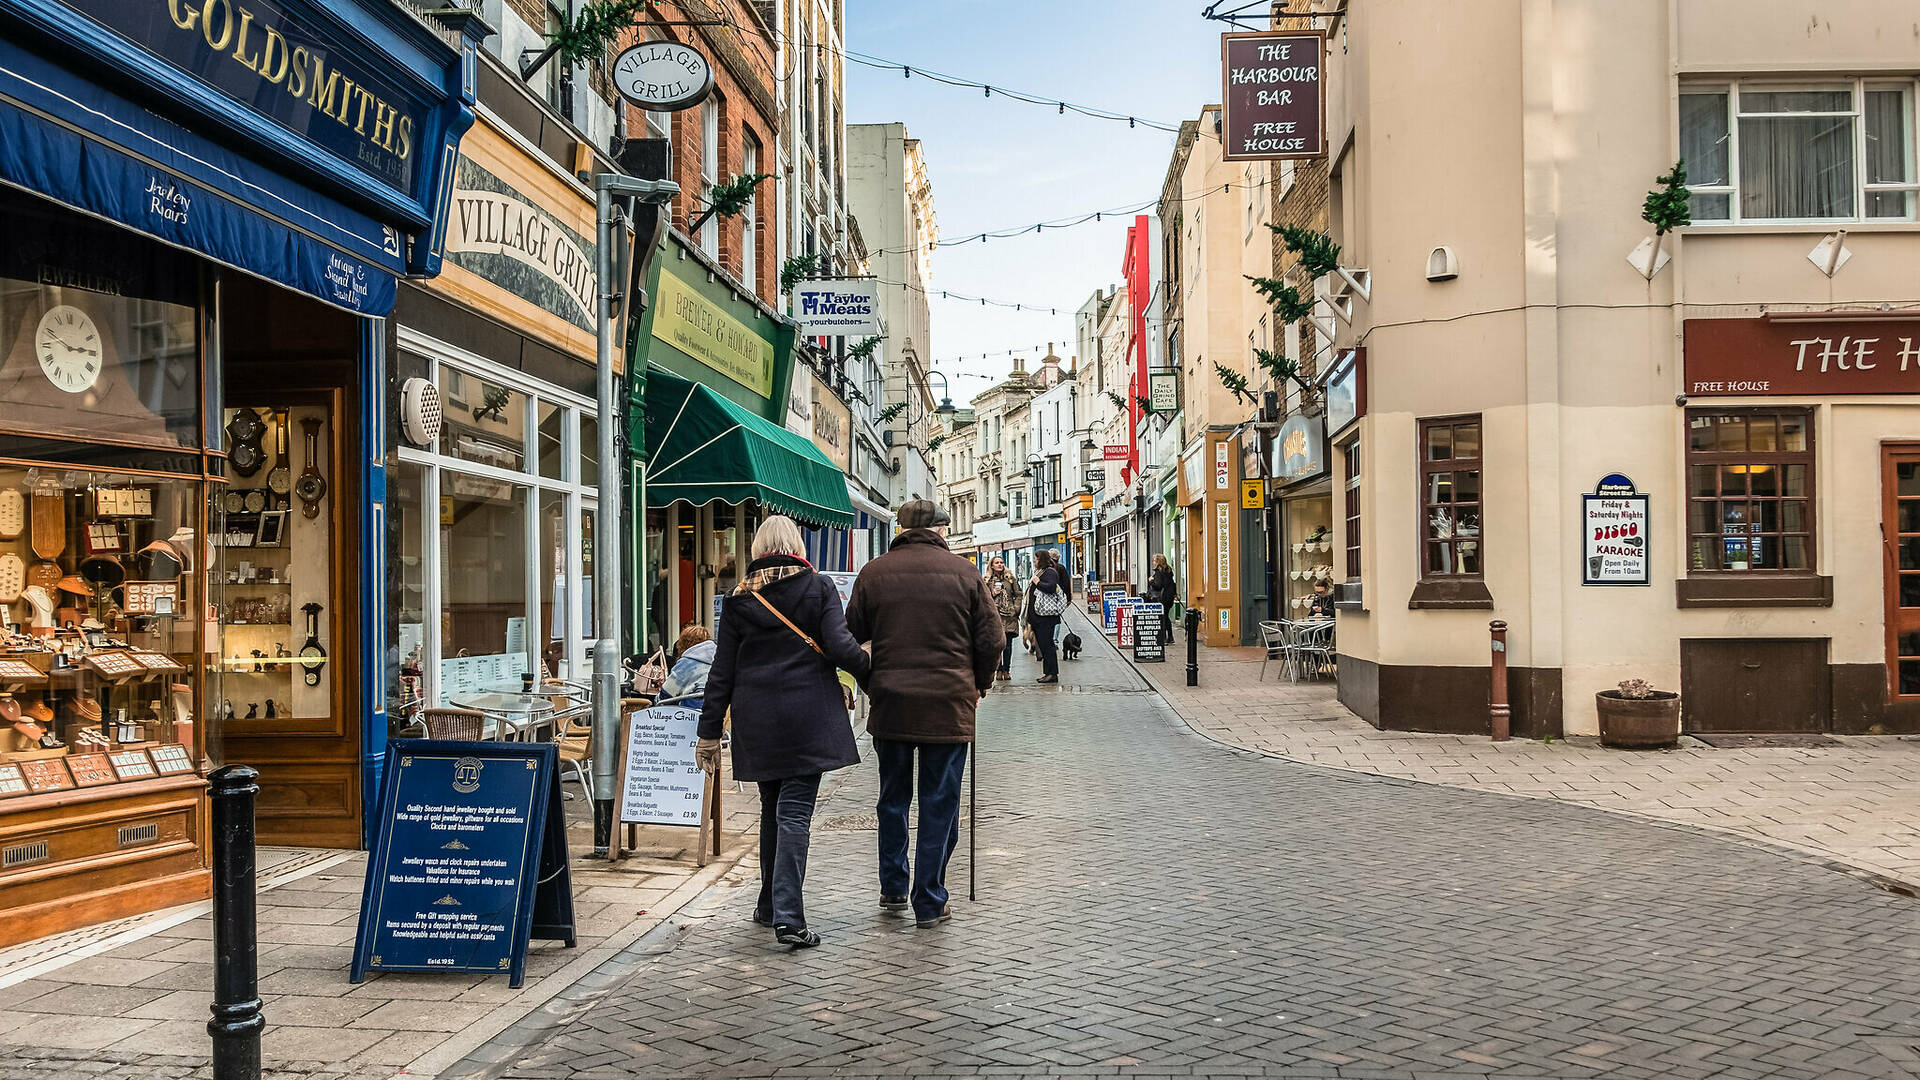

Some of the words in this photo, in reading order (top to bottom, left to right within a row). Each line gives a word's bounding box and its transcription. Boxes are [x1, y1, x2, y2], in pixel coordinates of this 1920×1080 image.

[1257, 44, 1291, 61] THE
[620, 47, 701, 75] VILLAGE
[1231, 66, 1318, 85] HARBOUR
[632, 79, 690, 99] GRILL
[1257, 89, 1292, 105] BAR
[1253, 122, 1297, 136] FREE
[1243, 138, 1307, 151] HOUSE
[457, 199, 550, 265] VILLAGE
[821, 292, 870, 305] Taylor
[820, 304, 871, 315] Meats
[675, 292, 712, 337] BREWER
[716, 318, 725, 342] &
[728, 327, 758, 363] HOWARD
[1789, 336, 1880, 373] THE
[1694, 381, 1724, 392] FREE
[1727, 380, 1770, 392] HOUSE
[1601, 501, 1622, 510] Friday
[1589, 511, 1620, 520] Saturday
[1621, 511, 1643, 520] Nights
[1594, 522, 1638, 541] DISCO
[1596, 545, 1643, 558] KARAOKE
[1604, 560, 1621, 568] Open
[1122, 618, 1133, 627] BU
[1121, 627, 1133, 636] AN
[1121, 637, 1134, 646] SE
[646, 709, 672, 722] Village
[674, 711, 696, 721] Grill
[407, 804, 423, 812] Quality
[424, 804, 442, 812] Second
[456, 805, 477, 814] jewellery
[478, 806, 494, 815] bought
[409, 814, 422, 822] range
[430, 814, 441, 822] gold
[465, 815, 484, 823] giftware
[458, 823, 484, 831] barometers
[402, 857, 424, 866] Jewellery
[463, 858, 480, 867] repairs
[480, 859, 507, 867] undertaken
[426, 867, 449, 875] Valuations
[440, 876, 449, 884] and
[449, 876, 463, 884] minor
[464, 877, 480, 885] repairs
[481, 877, 493, 885] while
[438, 913, 460, 922] wrapping
[460, 913, 478, 921] service
[401, 921, 420, 929] secured
[421, 921, 428, 930] by
[433, 921, 451, 930] deposit
[463, 923, 480, 931] regular
[393, 930, 428, 939] Knowledgeable
[440, 931, 456, 939] helpful
